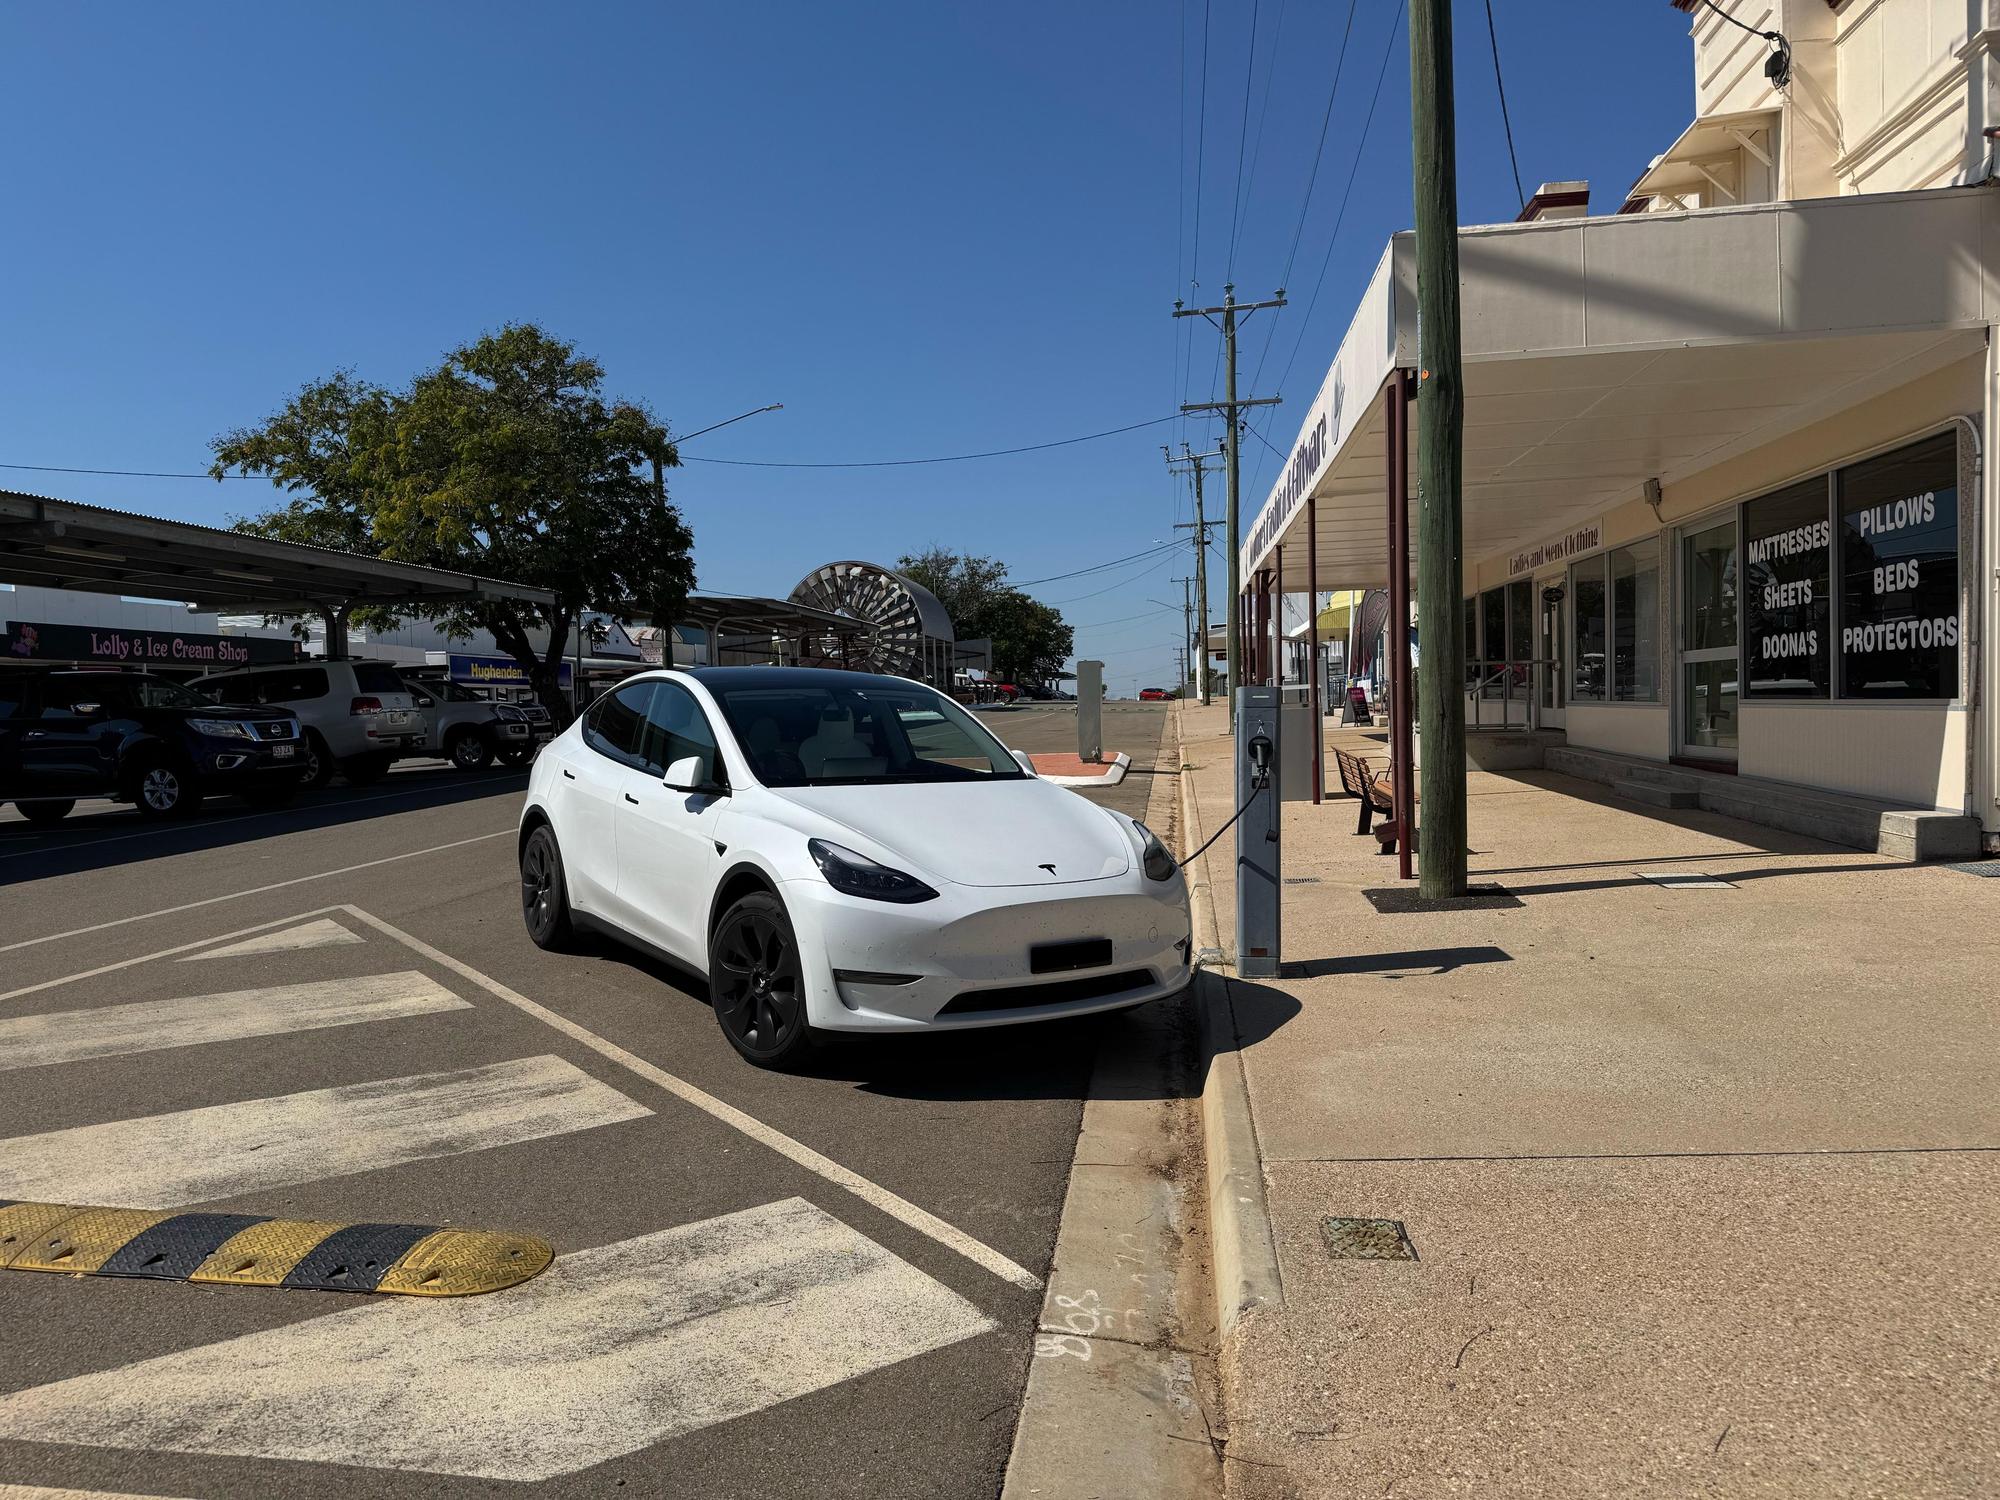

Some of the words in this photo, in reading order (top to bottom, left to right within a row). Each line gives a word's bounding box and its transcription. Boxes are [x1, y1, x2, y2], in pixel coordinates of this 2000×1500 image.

[1291, 411, 1328, 506] Giftware
[1859, 491, 1936, 538] PILLOWS
[1509, 553, 1530, 576] Ladies
[1530, 546, 1544, 568] and
[1545, 541, 1563, 562] Mens
[1564, 527, 1599, 557] Clothing
[1748, 520, 1831, 565] MATTRESSES
[1763, 578, 1813, 610] SHEETS
[1873, 558, 1920, 595] BEDS
[91, 632, 129, 660] Lolly
[133, 638, 143, 656] &
[146, 636, 168, 657] Ice
[172, 638, 215, 660] Cream
[217, 640, 249, 663] Shop
[1762, 629, 1818, 659] DOONA'S
[1842, 616, 1958, 654] PROTECTORS
[470, 662, 523, 681] Hughenden
